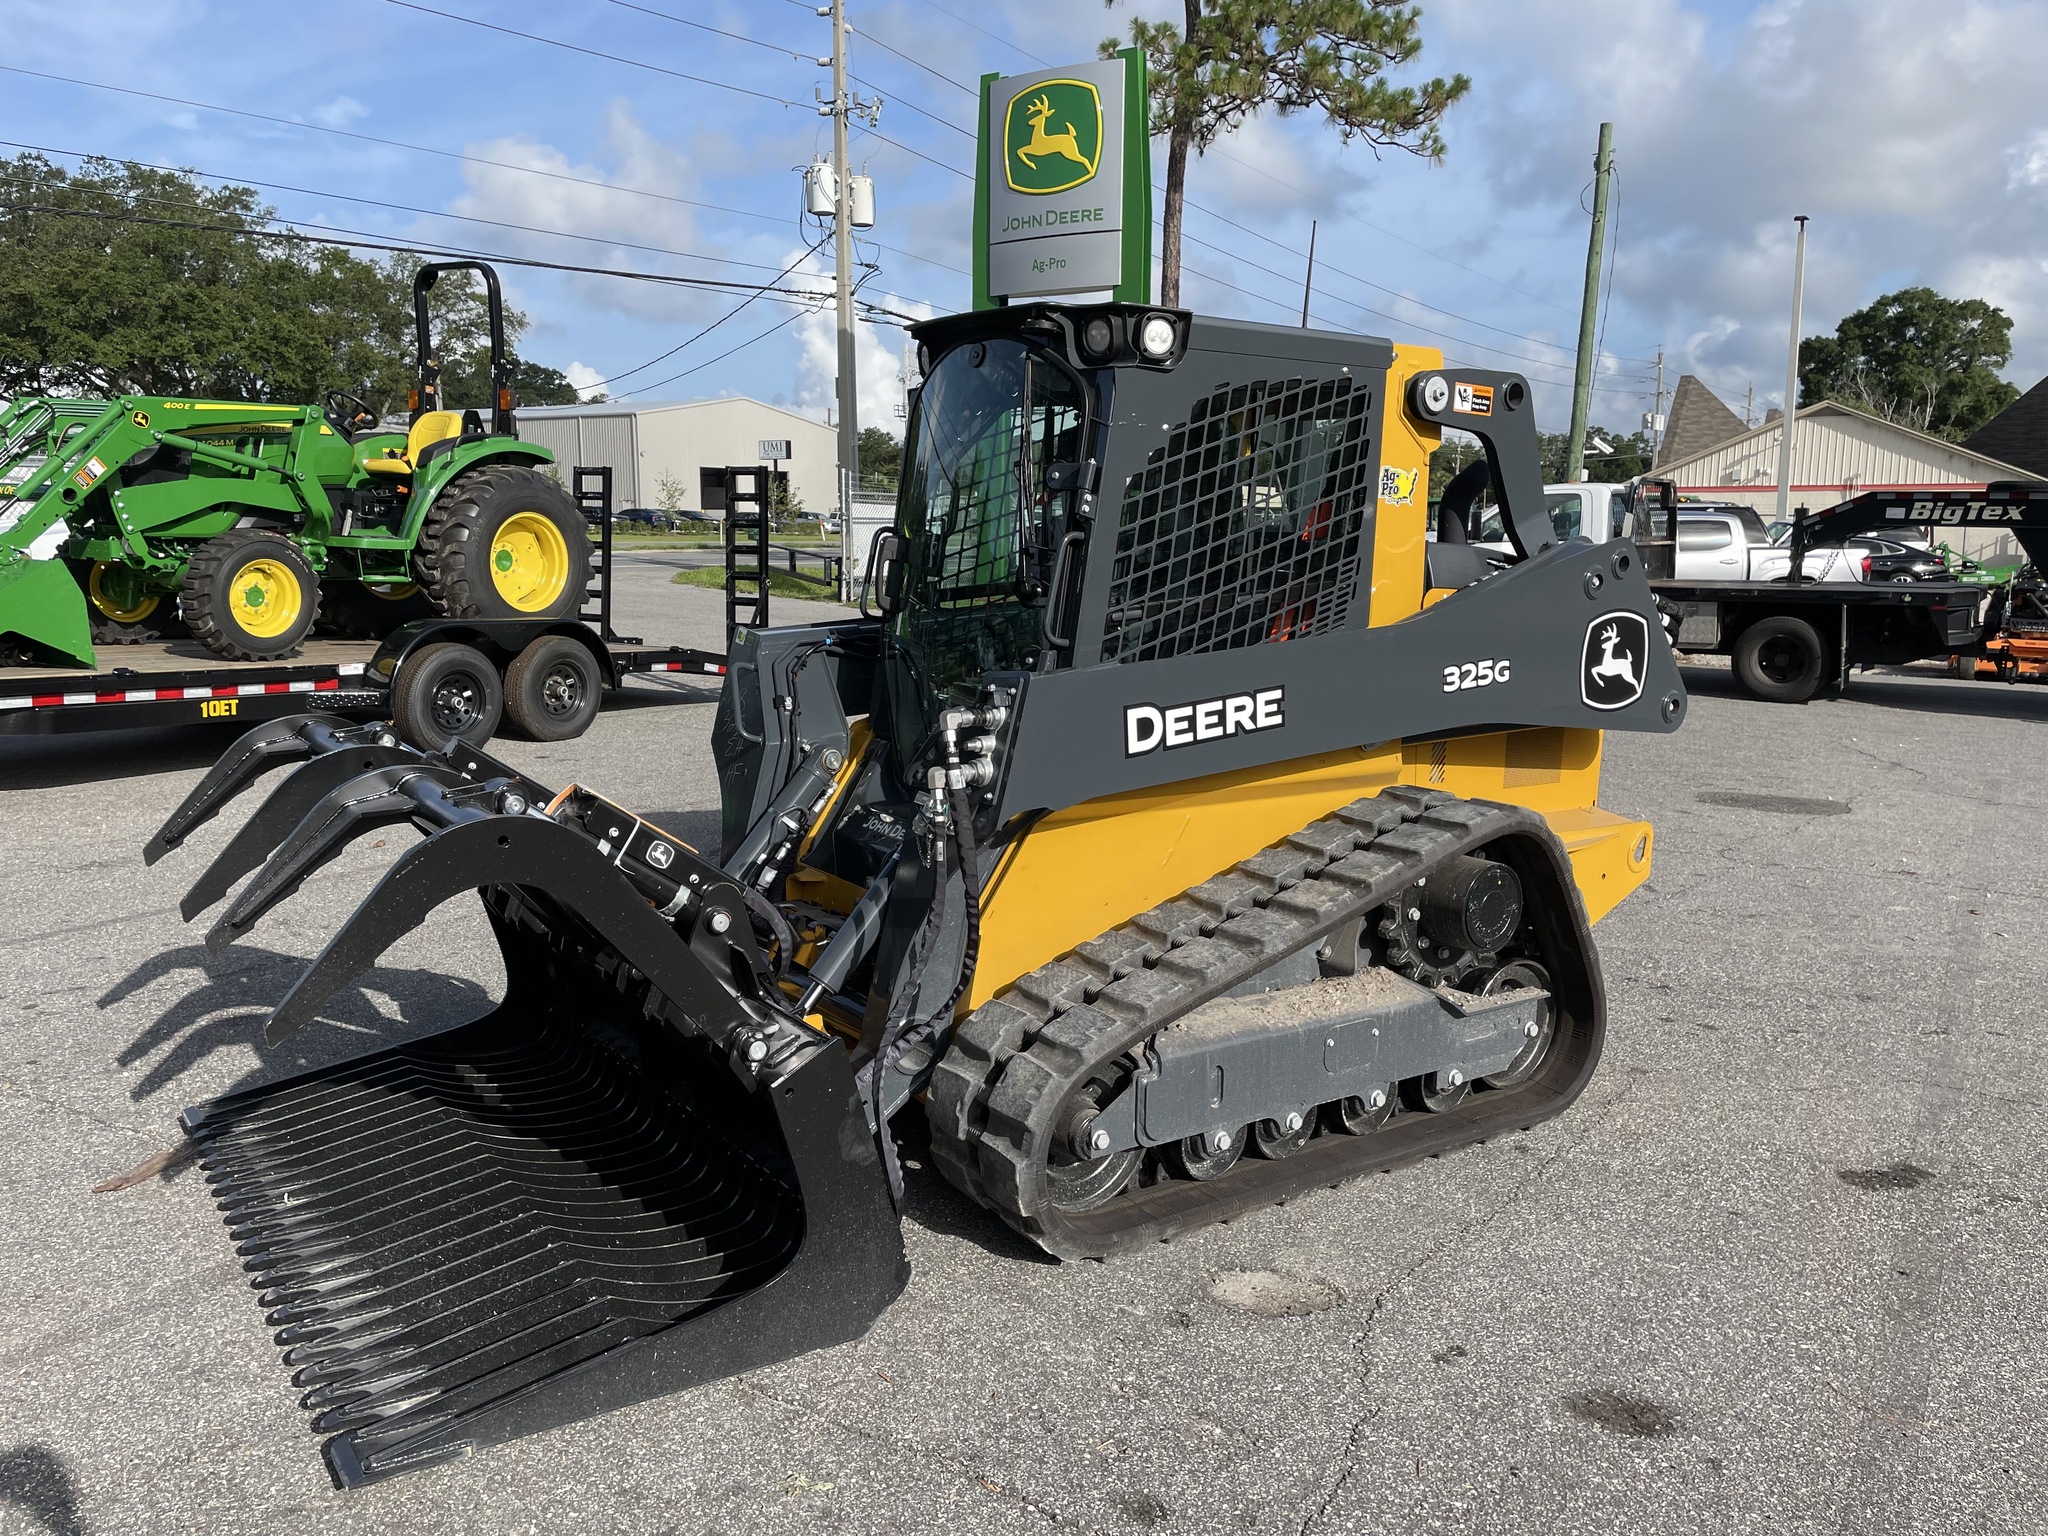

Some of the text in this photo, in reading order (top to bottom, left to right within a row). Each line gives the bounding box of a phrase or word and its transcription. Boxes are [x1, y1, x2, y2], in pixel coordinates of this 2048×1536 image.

[1002, 208, 1104, 232] JOHN DEERE
[1032, 257, 1066, 273] Ag-Pro
[240, 424, 287, 433] JOHN DEERE
[763, 441, 783, 452] UMI
[1381, 483, 1399, 496] Pro
[1443, 659, 1511, 692] 325G
[200, 699, 239, 718] 10ET
[1126, 688, 1283, 755] DEERE
[863, 816, 906, 840] JOHN DE
